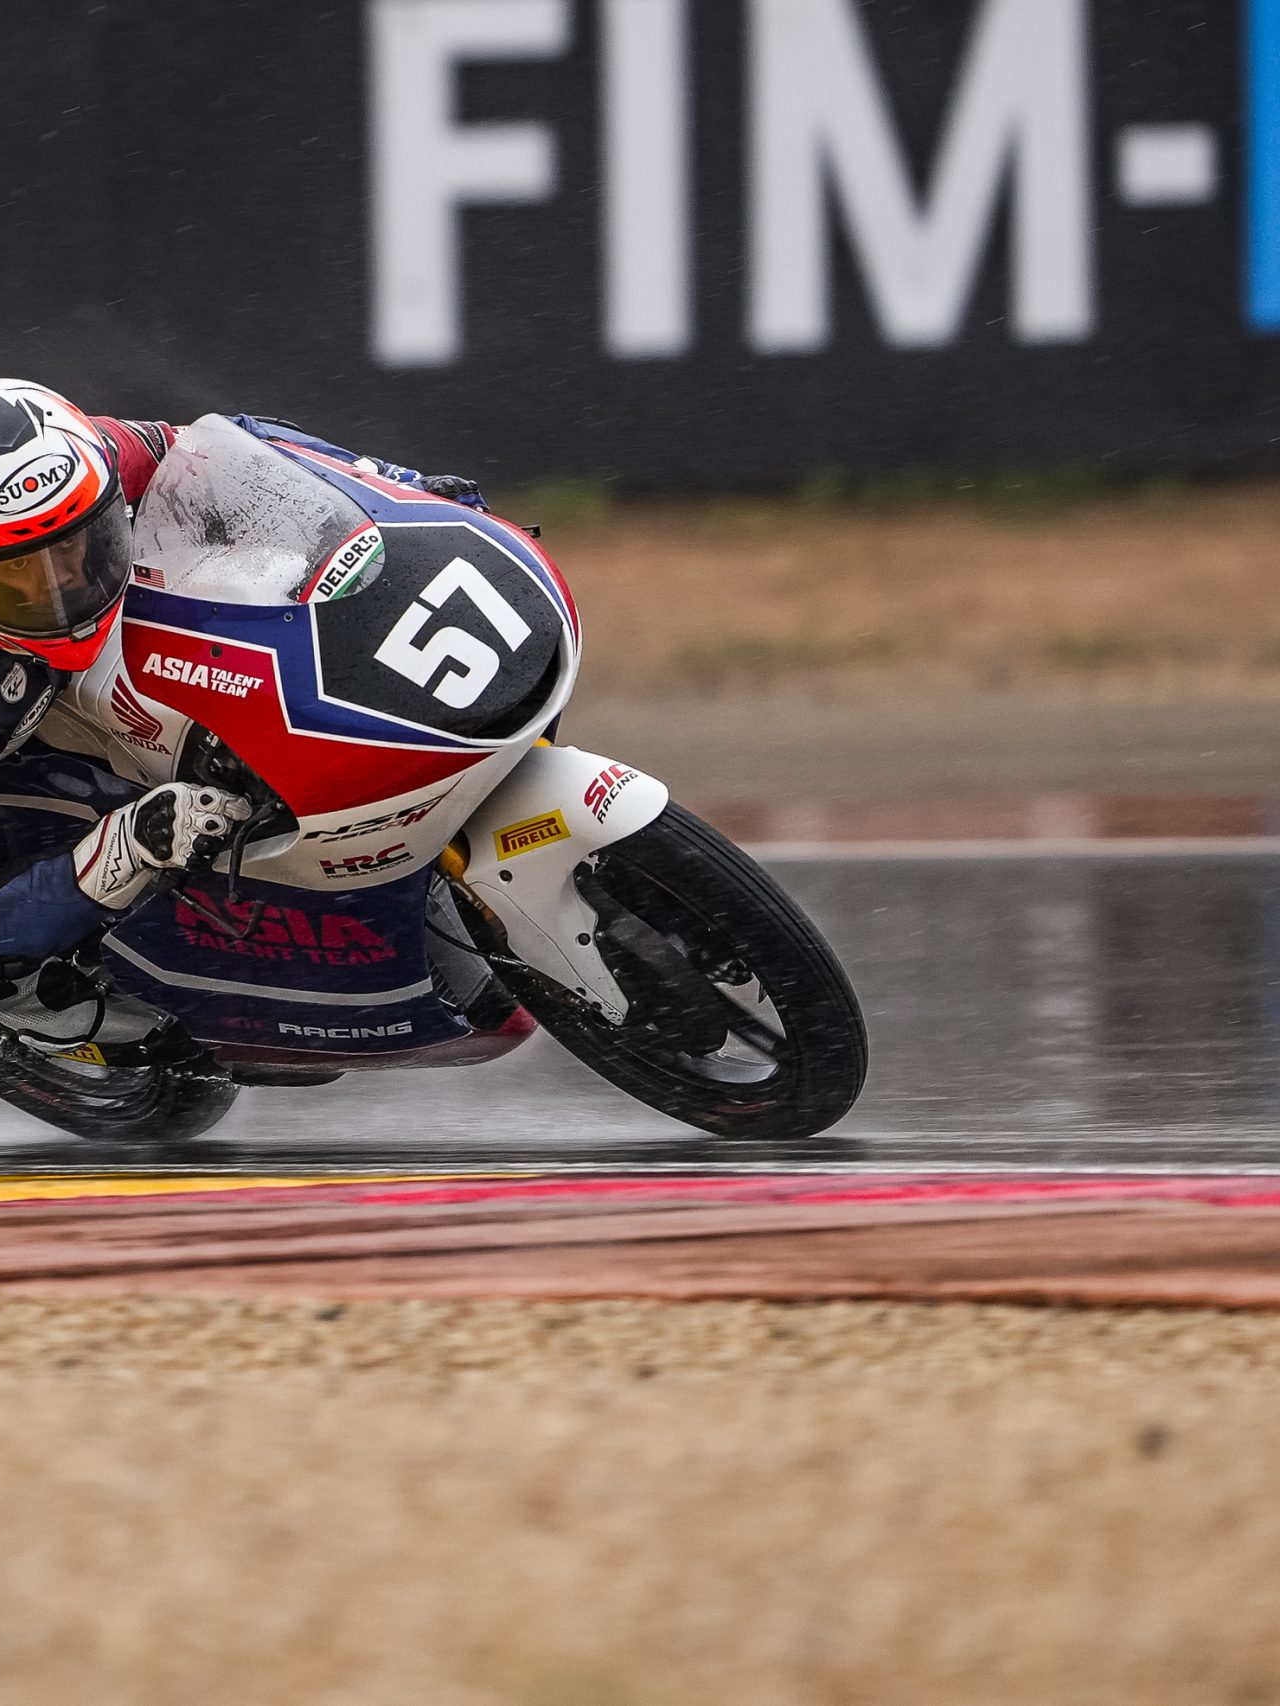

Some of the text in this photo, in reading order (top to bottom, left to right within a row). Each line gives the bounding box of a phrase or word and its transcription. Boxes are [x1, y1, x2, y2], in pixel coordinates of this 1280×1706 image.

[368, 0, 1280, 366] FIM-
[317, 536, 379, 597] DELLORTO
[374, 556, 532, 709] 57
[142, 653, 264, 689] ASIA TALENT
[210, 679, 248, 698] TEAM
[109, 727, 173, 756] HONDA
[584, 763, 633, 816] SIC
[596, 772, 639, 825] RACING
[500, 817, 562, 853] PIRELLI
[320, 842, 412, 875] HRC
[176, 887, 386, 949] ASIA
[179, 928, 398, 966] TALENT TEAM
[278, 1020, 413, 1039] RACING
